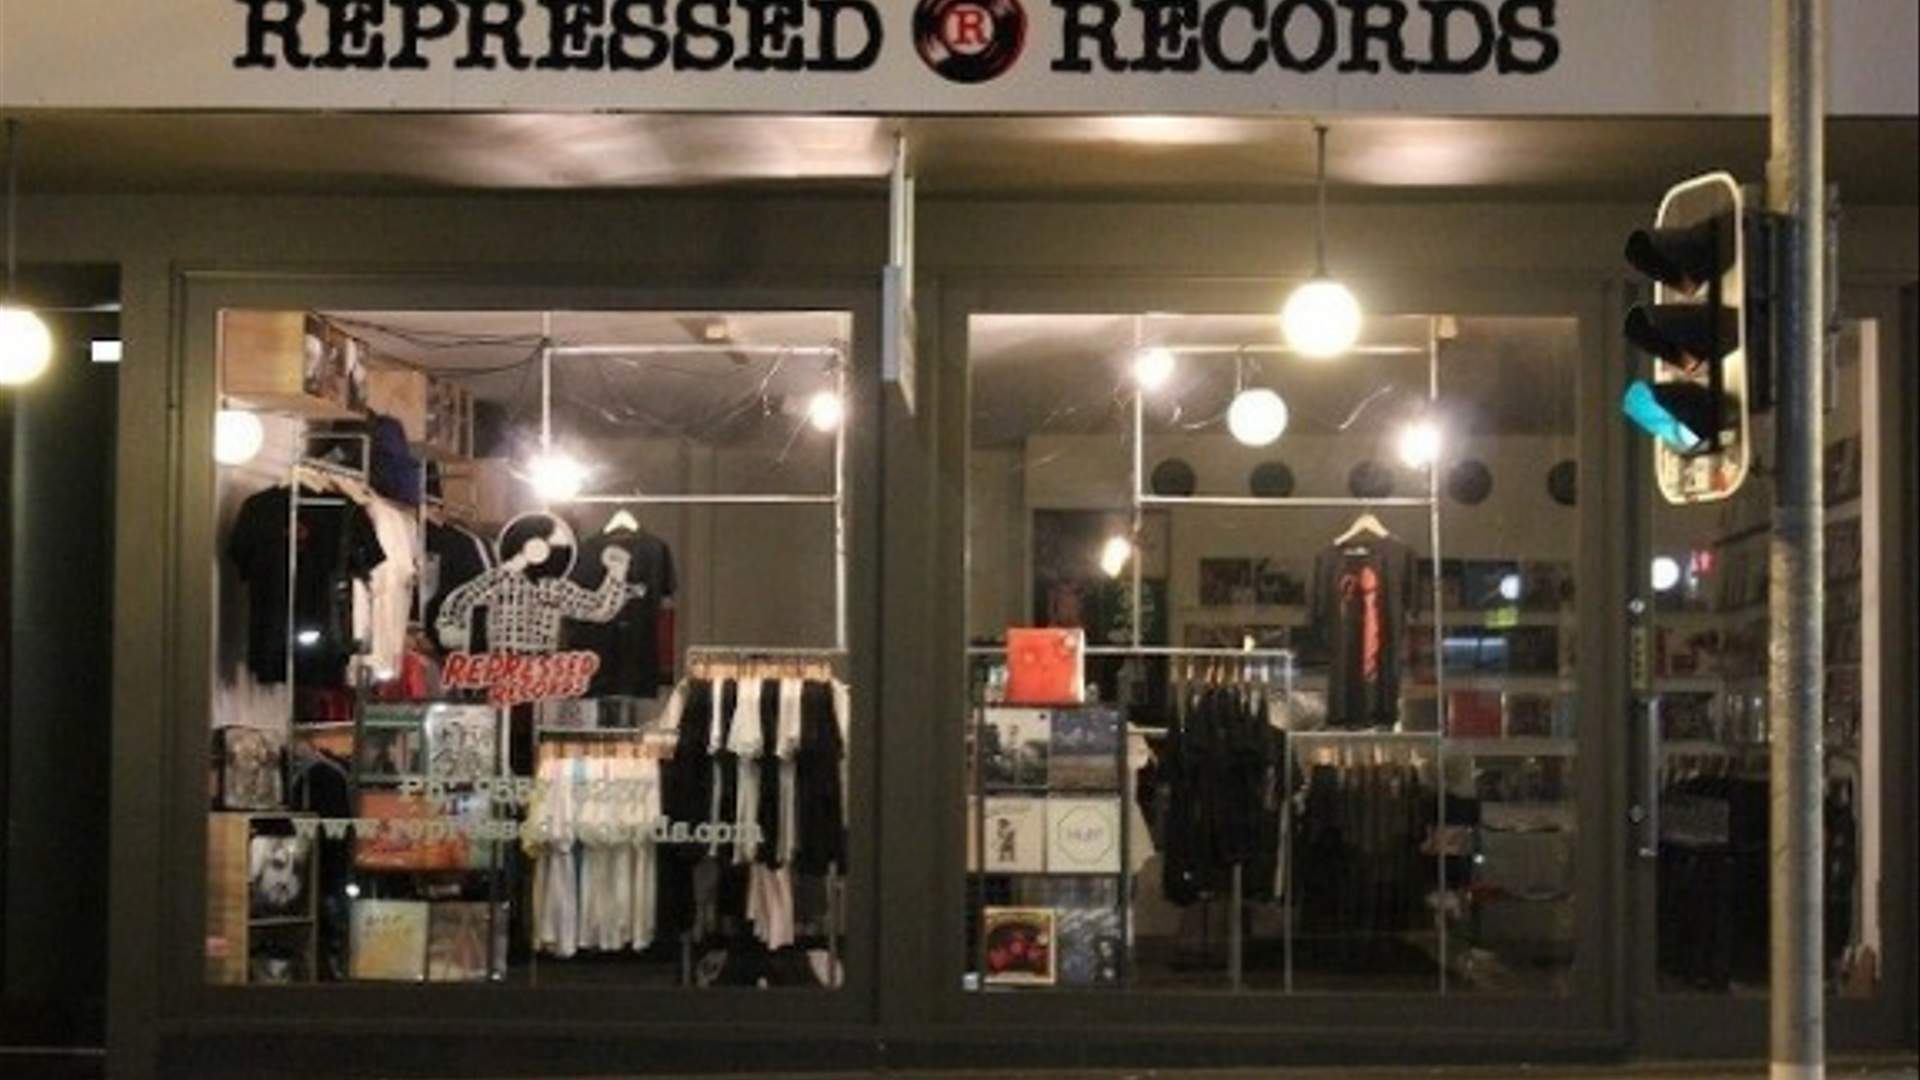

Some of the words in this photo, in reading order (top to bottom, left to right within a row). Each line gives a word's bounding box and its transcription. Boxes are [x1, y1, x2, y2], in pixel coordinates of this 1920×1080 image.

[234, 0, 884, 72] REPRESSED
[952, 10, 988, 44] R
[1051, 0, 1561, 75] RECORDS
[443, 651, 600, 688] REPRESSED
